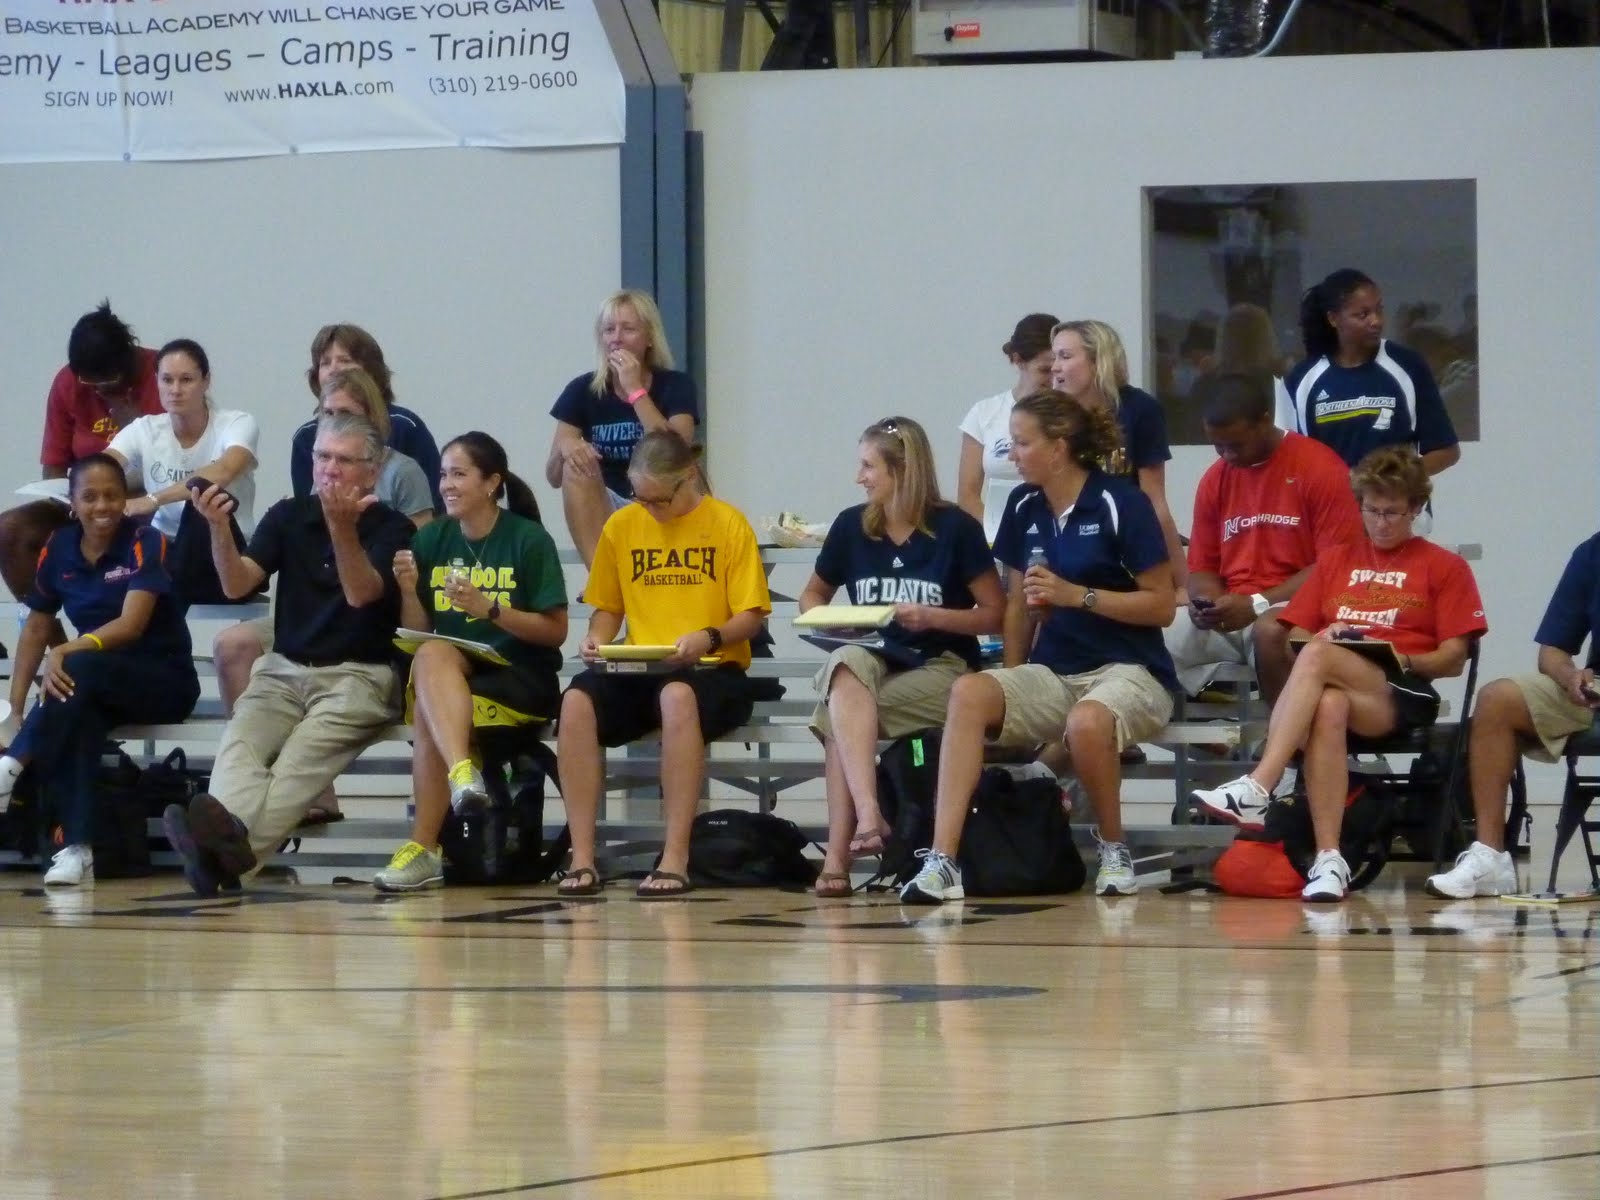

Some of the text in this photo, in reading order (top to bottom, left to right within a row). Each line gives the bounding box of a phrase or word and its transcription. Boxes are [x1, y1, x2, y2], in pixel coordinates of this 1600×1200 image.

[5, 0, 565, 35] BASKETBALL ACADEMY WILL CHANGE YOUR GAME
[0, 52, 61, 81] emy
[99, 48, 232, 81] Leagues
[280, 37, 393, 68] Camps
[430, 27, 570, 61] Training
[224, 79, 394, 103] www.HAXLA.com
[428, 70, 578, 96] (310) 219-0600
[44, 90, 173, 107] SIGN UP NOW!
[1223, 513, 1301, 542] NORHRIDGE
[631, 547, 716, 582] BEACH
[644, 574, 703, 585] BASKETBALL
[855, 576, 943, 606] UC DAVIS
[1348, 569, 1407, 589] SWEET
[1336, 605, 1399, 625] SIXTEEN
